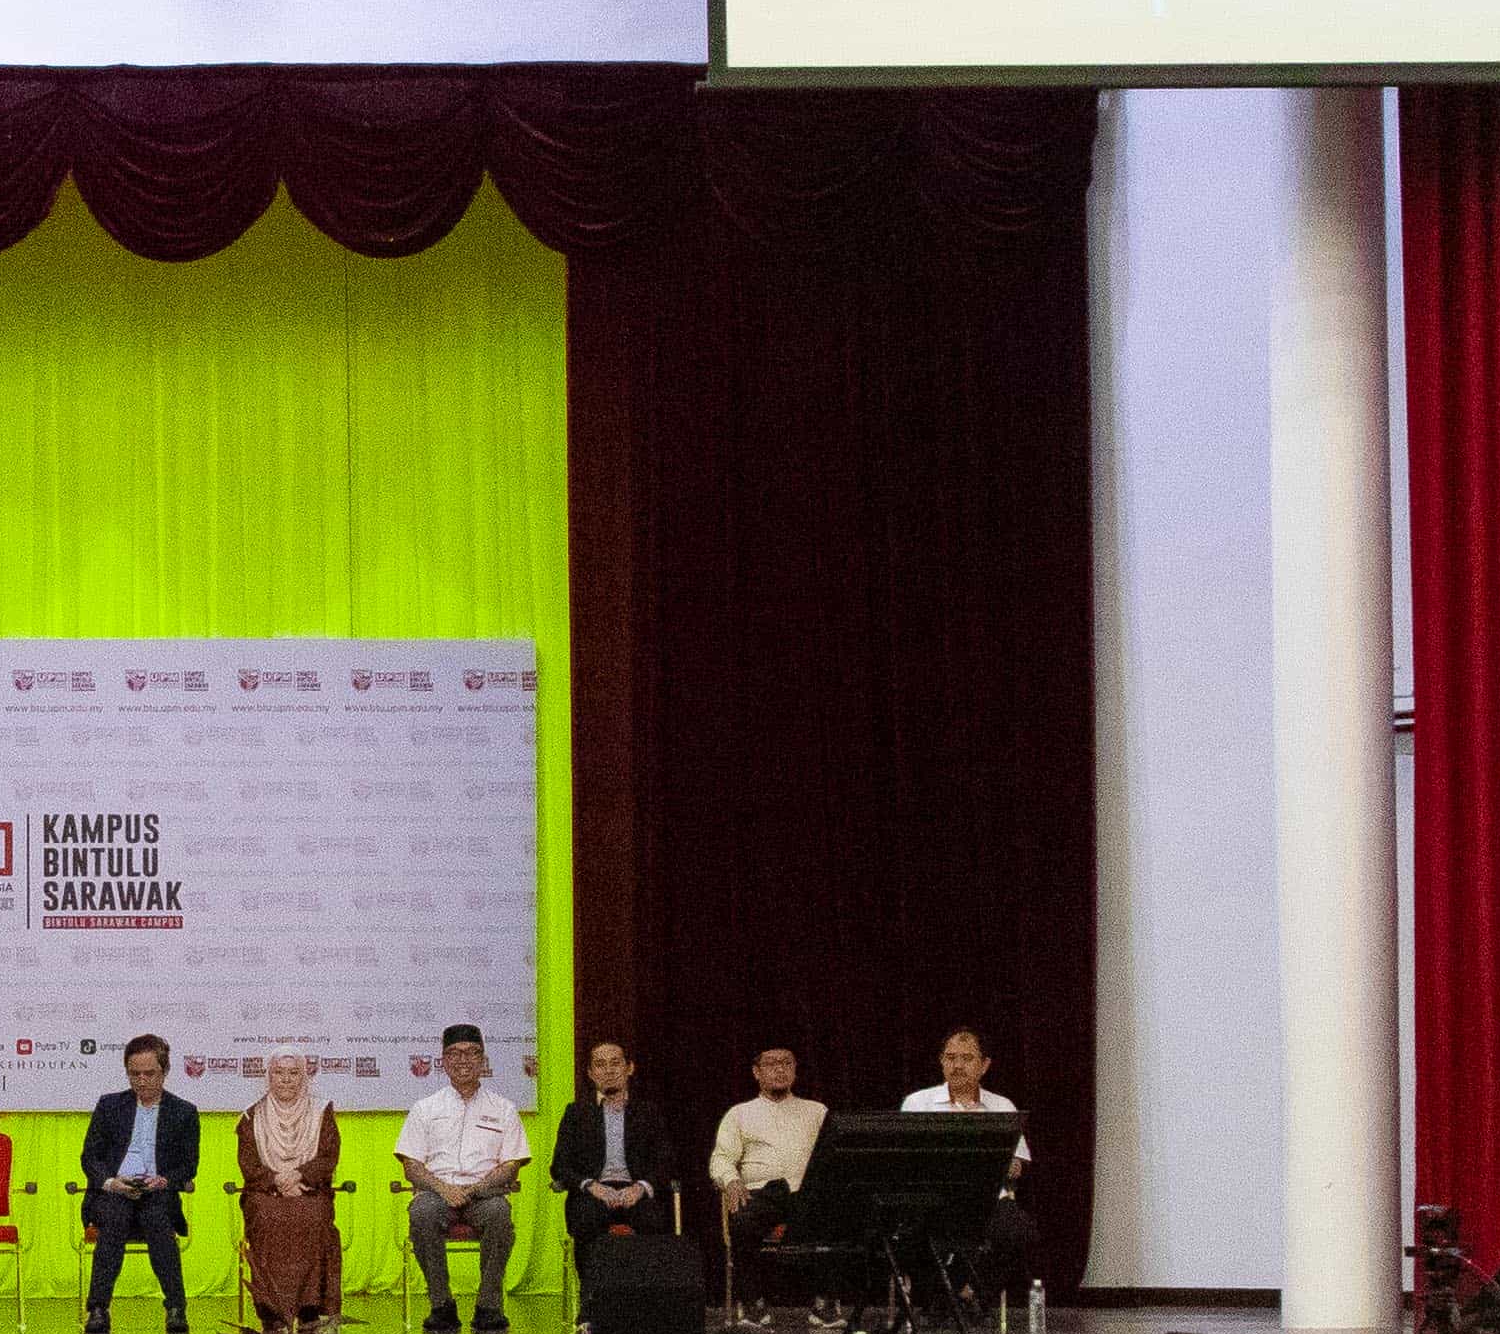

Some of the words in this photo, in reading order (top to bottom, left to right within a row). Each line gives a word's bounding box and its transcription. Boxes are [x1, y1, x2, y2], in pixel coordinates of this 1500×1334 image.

[43, 813, 160, 844] KAMPUS
[43, 848, 159, 877] BINTULU
[43, 881, 183, 911] SARAWAK
[44, 917, 86, 928] BINTULU
[89, 917, 137, 928] SARAWAK
[140, 917, 181, 928] CAMPUS
[35, 1041, 57, 1052] Putra
[58, 1041, 70, 1051] TV
